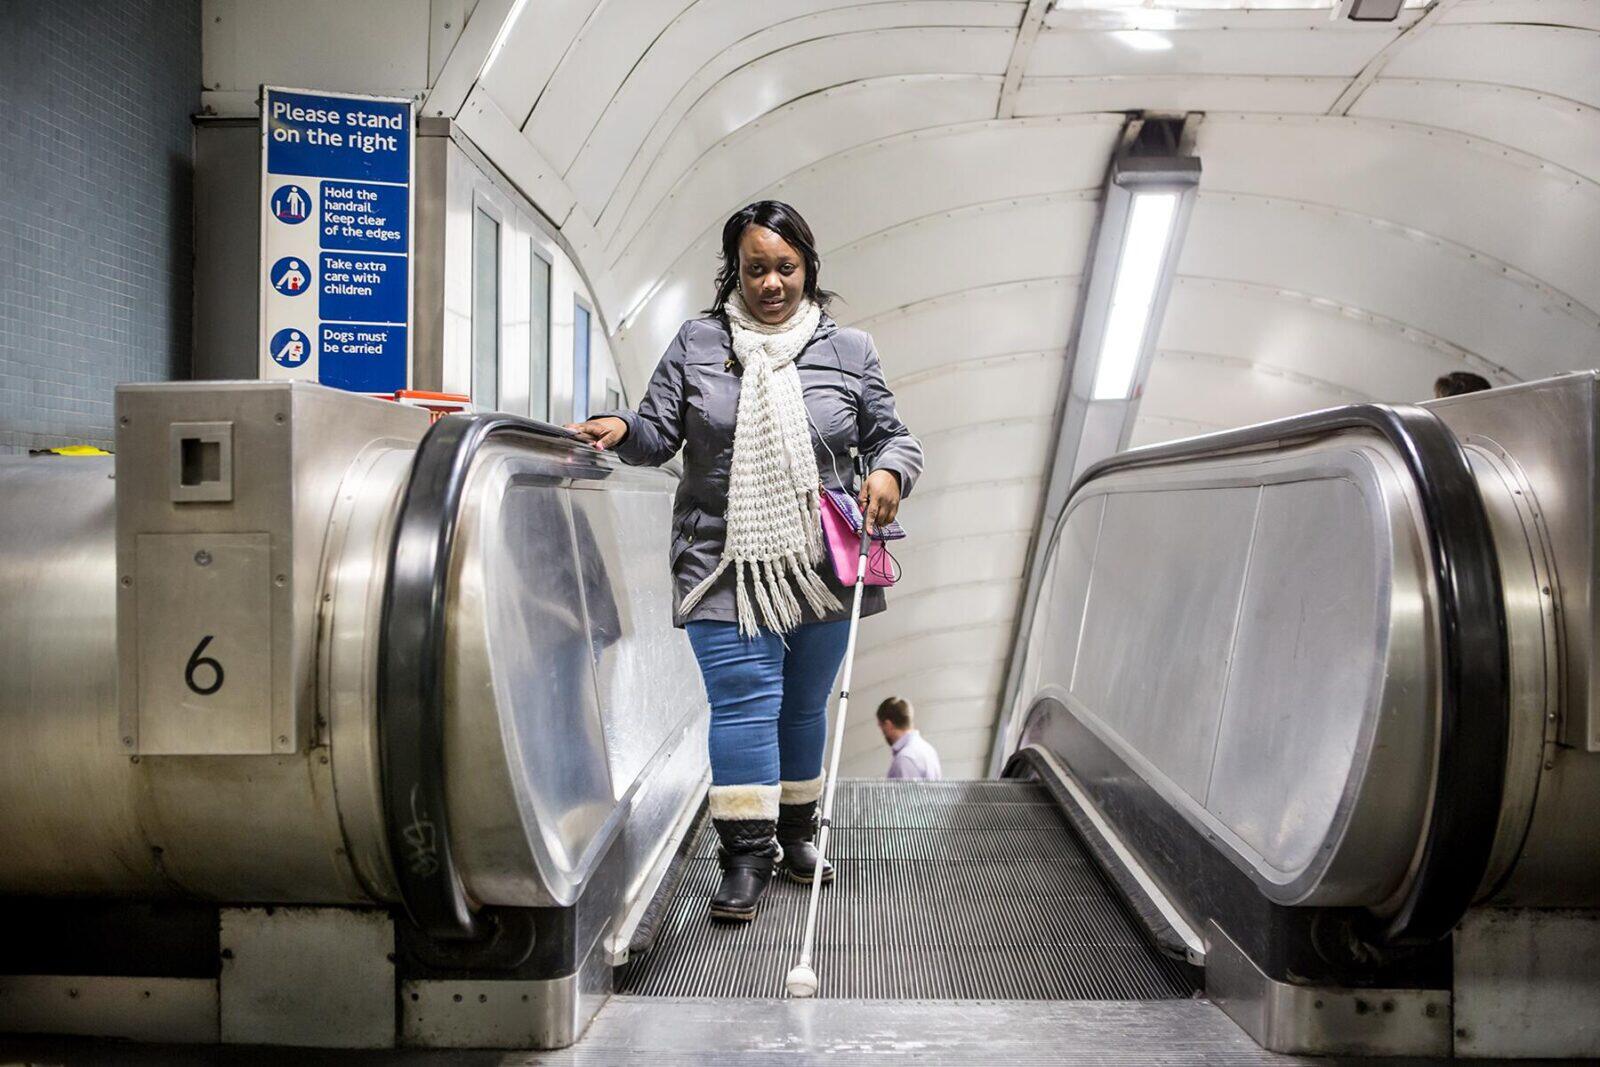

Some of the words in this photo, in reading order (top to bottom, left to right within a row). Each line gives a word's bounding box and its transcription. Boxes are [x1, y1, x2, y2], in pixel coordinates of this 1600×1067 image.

[273, 102, 340, 125] Please
[346, 111, 403, 130] stand
[273, 128, 300, 143] on
[306, 128, 343, 147] the
[348, 131, 398, 153] right
[324, 186, 353, 199] Hold
[356, 189, 378, 201] the
[324, 199, 372, 213] handrail
[324, 212, 355, 226] Keep
[357, 215, 386, 226] clear
[324, 225, 339, 236] of
[342, 226, 363, 237] the
[365, 228, 401, 241] edges
[324, 257, 352, 270] Take
[354, 261, 387, 272] extra
[323, 272, 350, 282] care
[352, 272, 381, 284] with
[323, 284, 373, 296] children
[323, 329, 355, 343] Dogs
[357, 332, 388, 342] must
[323, 342, 340, 353] be
[342, 343, 383, 354] carried
[185, 635, 224, 696] 6
